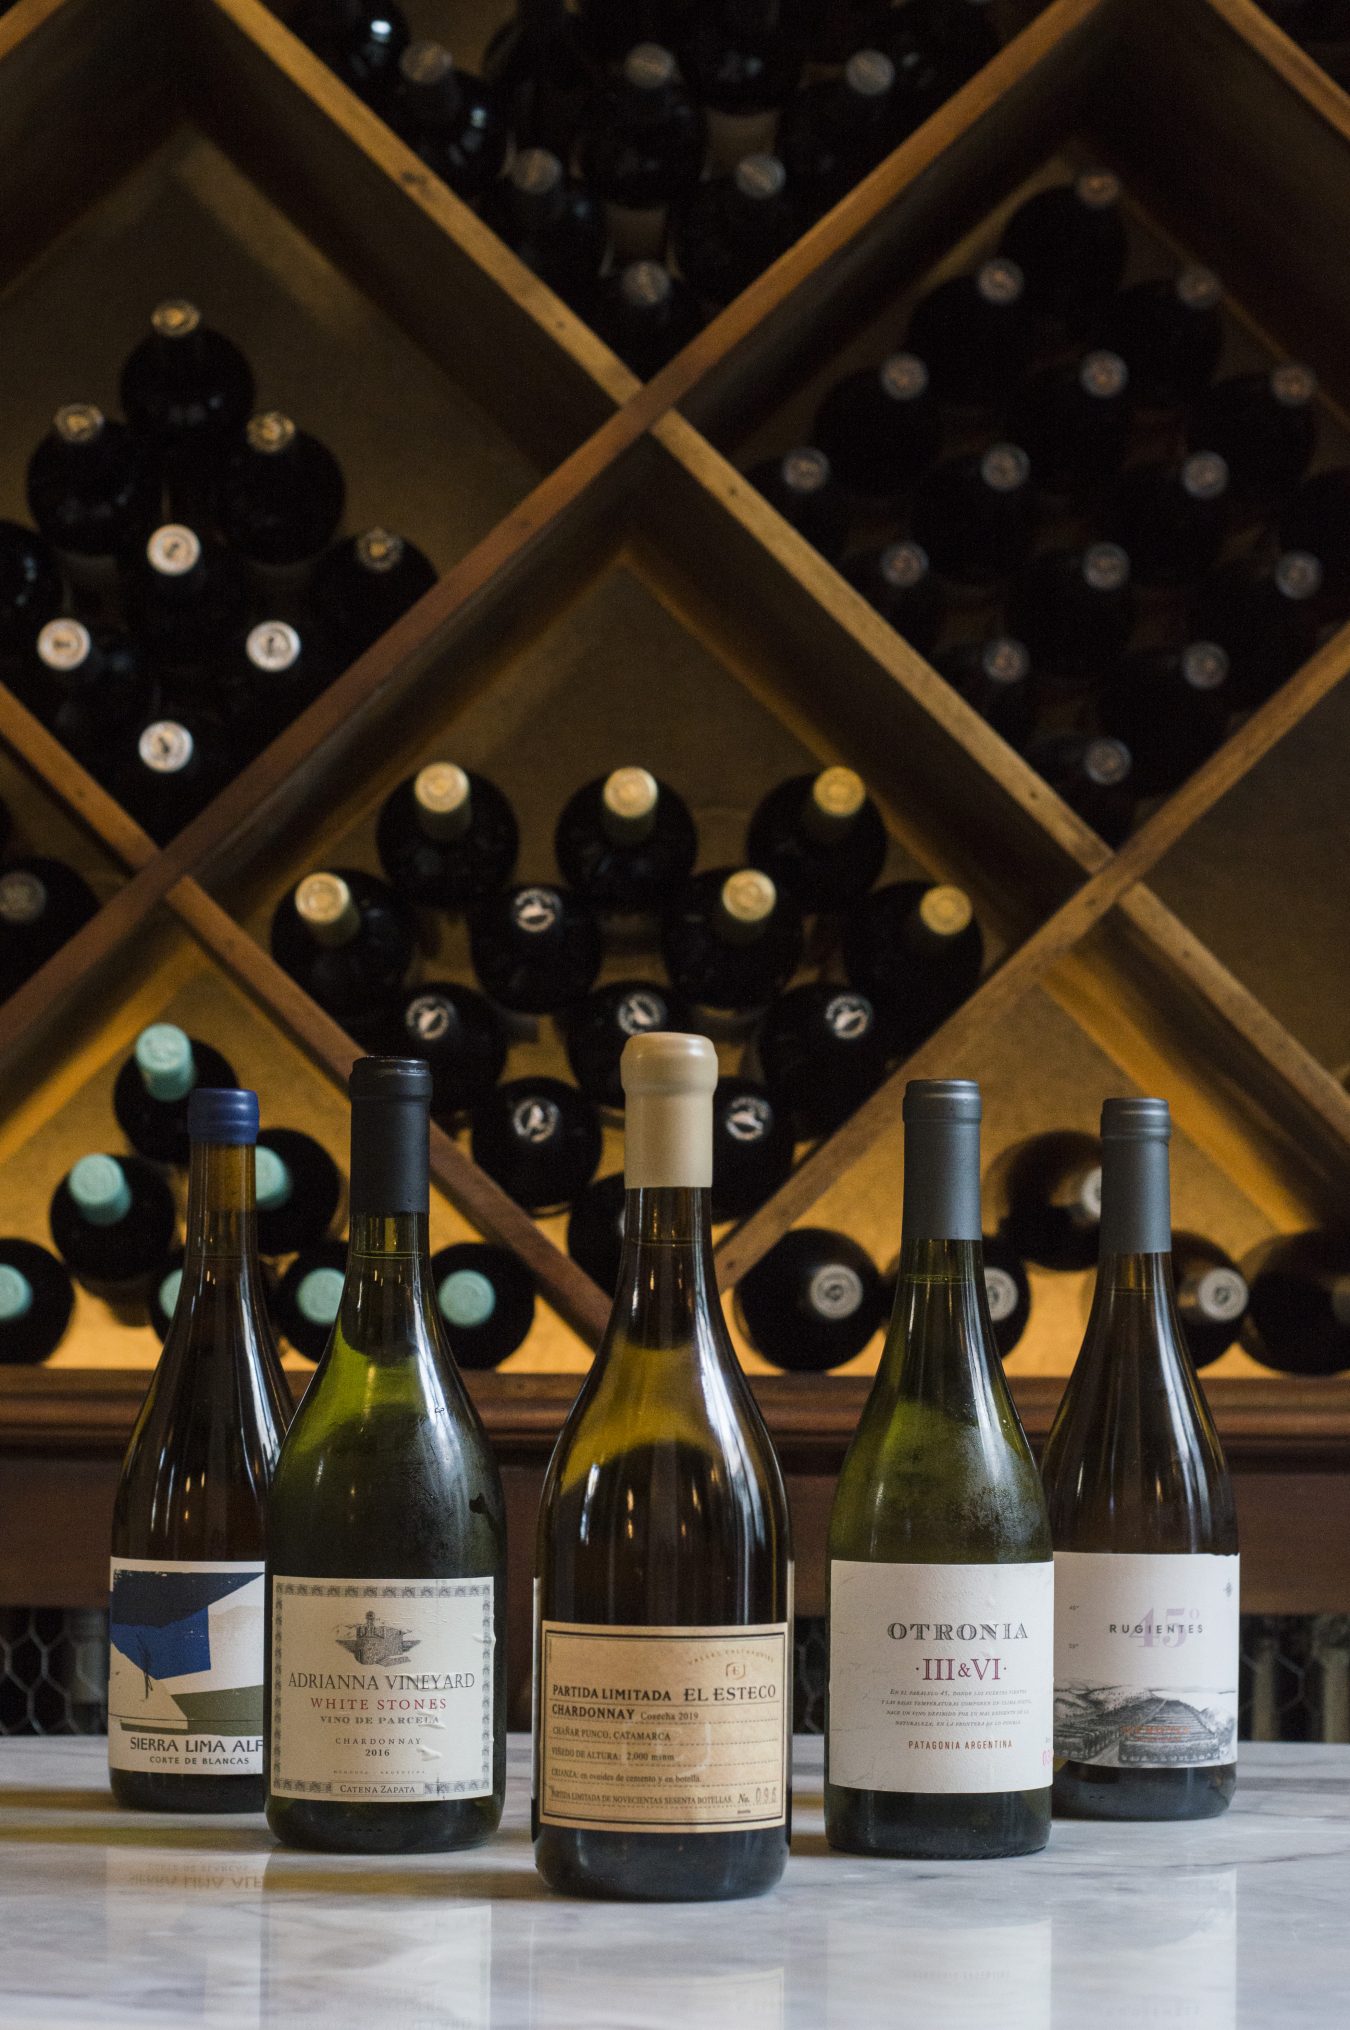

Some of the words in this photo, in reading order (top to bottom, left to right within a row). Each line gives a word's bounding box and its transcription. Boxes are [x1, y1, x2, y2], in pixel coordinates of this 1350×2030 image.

[887, 1622, 1028, 1640] OTRONIA
[1109, 1624, 1204, 1634] RUGIENTES
[288, 1672, 379, 1690] ADRIANNA
[384, 1672, 475, 1690] VINEYARD
[553, 1684, 599, 1699] PARTIDA
[602, 1688, 672, 1701] LIMITADA
[683, 1688, 709, 1702] EL
[713, 1684, 776, 1701] ESTECO
[311, 1697, 369, 1710] WHITE
[377, 1698, 447, 1710] STONES
[552, 1704, 635, 1720] CHARDONNAY
[640, 1711, 676, 1721] Cosecha
[678, 1711, 699, 1721] 2019
[320, 1716, 350, 1724] VINO
[379, 1716, 440, 1725] PARCELA
[335, 1737, 421, 1745] CHARDONNAY
[613, 1731, 671, 1741] CATAMARCA
[130, 1737, 179, 1752] SIERRA
[185, 1739, 226, 1753] LIMA
[908, 1740, 960, 1750] PATAGONIA
[964, 1740, 1012, 1750] ARGENTINA
[365, 1748, 391, 1757] 2016
[576, 1749, 585, 1759] DE
[149, 1756, 180, 1764] CORTE
[184, 1757, 197, 1765] DE
[202, 1757, 249, 1765] BLANCAS
[615, 1773, 624, 1782] de
[340, 1784, 378, 1794] CATENA
[380, 1785, 416, 1794] ZAPATA
[602, 1794, 611, 1803] DE
[613, 1795, 663, 1805] NOVECIENTAS
